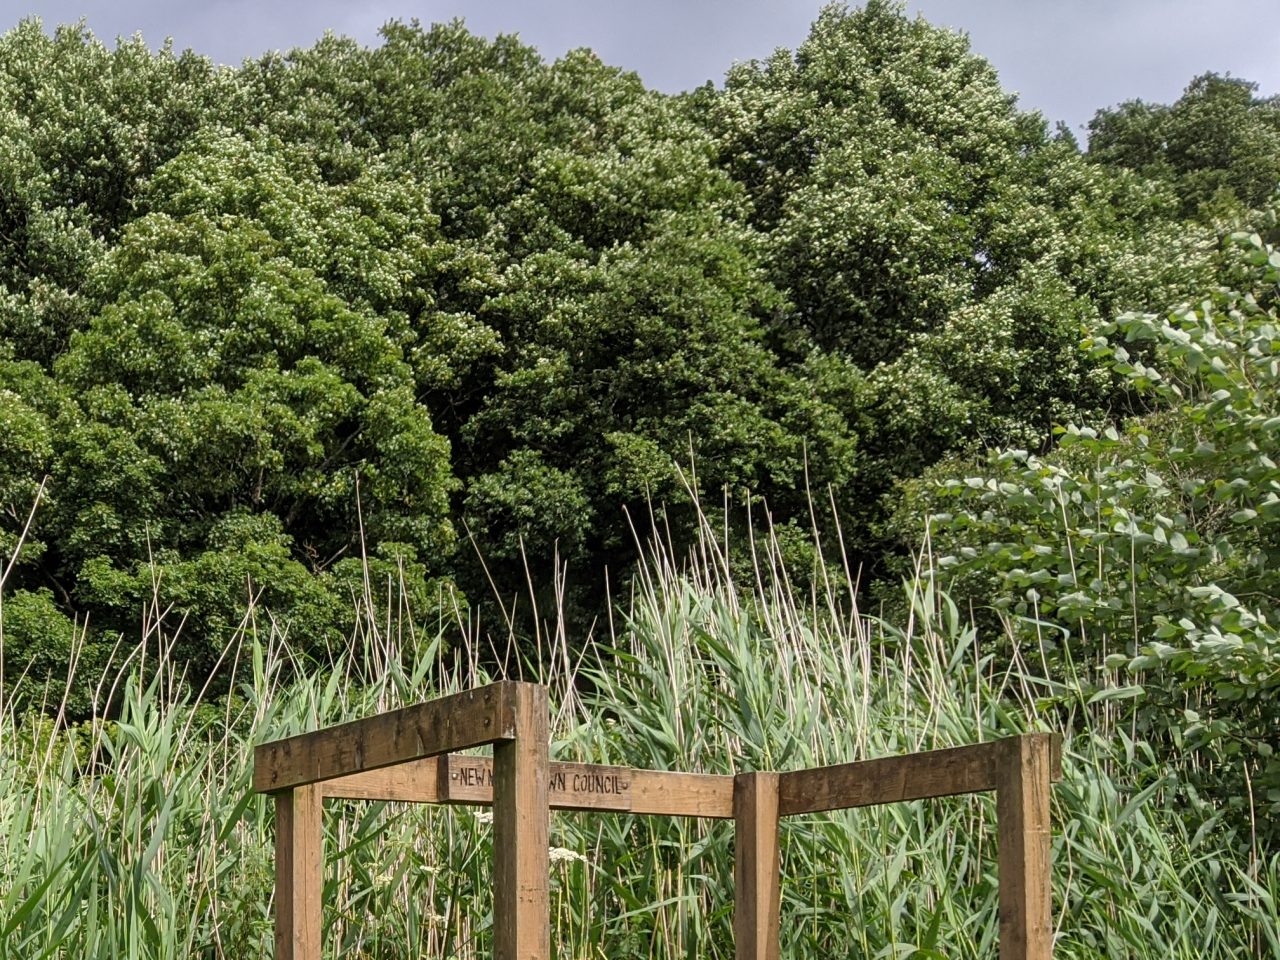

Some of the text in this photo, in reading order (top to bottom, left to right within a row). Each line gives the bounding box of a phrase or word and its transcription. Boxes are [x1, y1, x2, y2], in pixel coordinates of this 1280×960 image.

[460, 767, 485, 786] NEW
[549, 773, 566, 792] WN
[574, 774, 622, 795] COUNCIL
